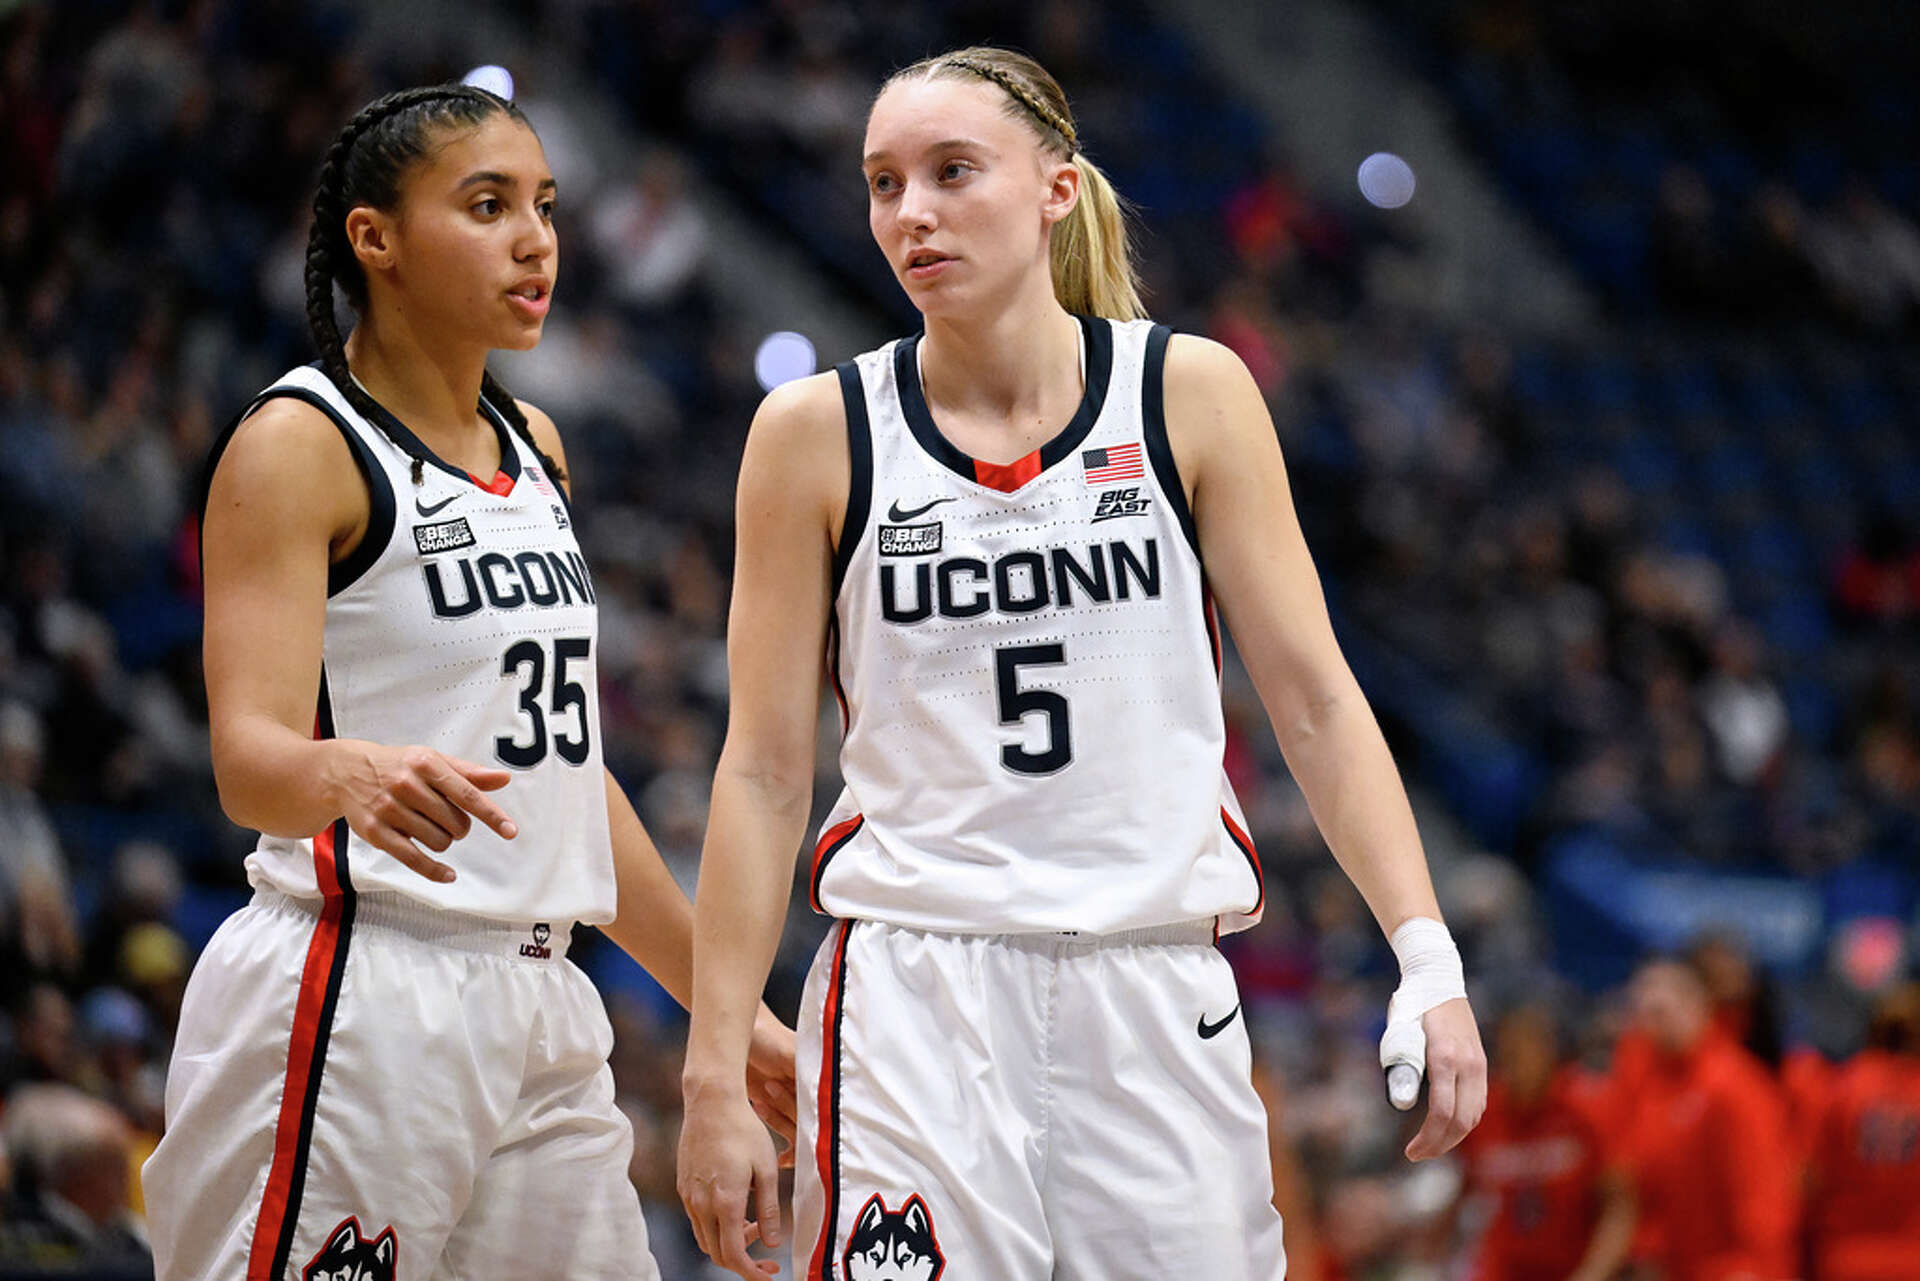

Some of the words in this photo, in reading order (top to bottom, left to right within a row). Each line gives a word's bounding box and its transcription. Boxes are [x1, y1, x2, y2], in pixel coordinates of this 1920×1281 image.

[1099, 487, 1140, 503] BIG
[1094, 499, 1152, 516] EAST
[420, 533, 472, 552] CHANGE
[881, 539, 940, 553] CHANGE
[879, 538, 1161, 626] UCONN
[495, 637, 591, 769] 35
[994, 642, 1074, 777] 5
